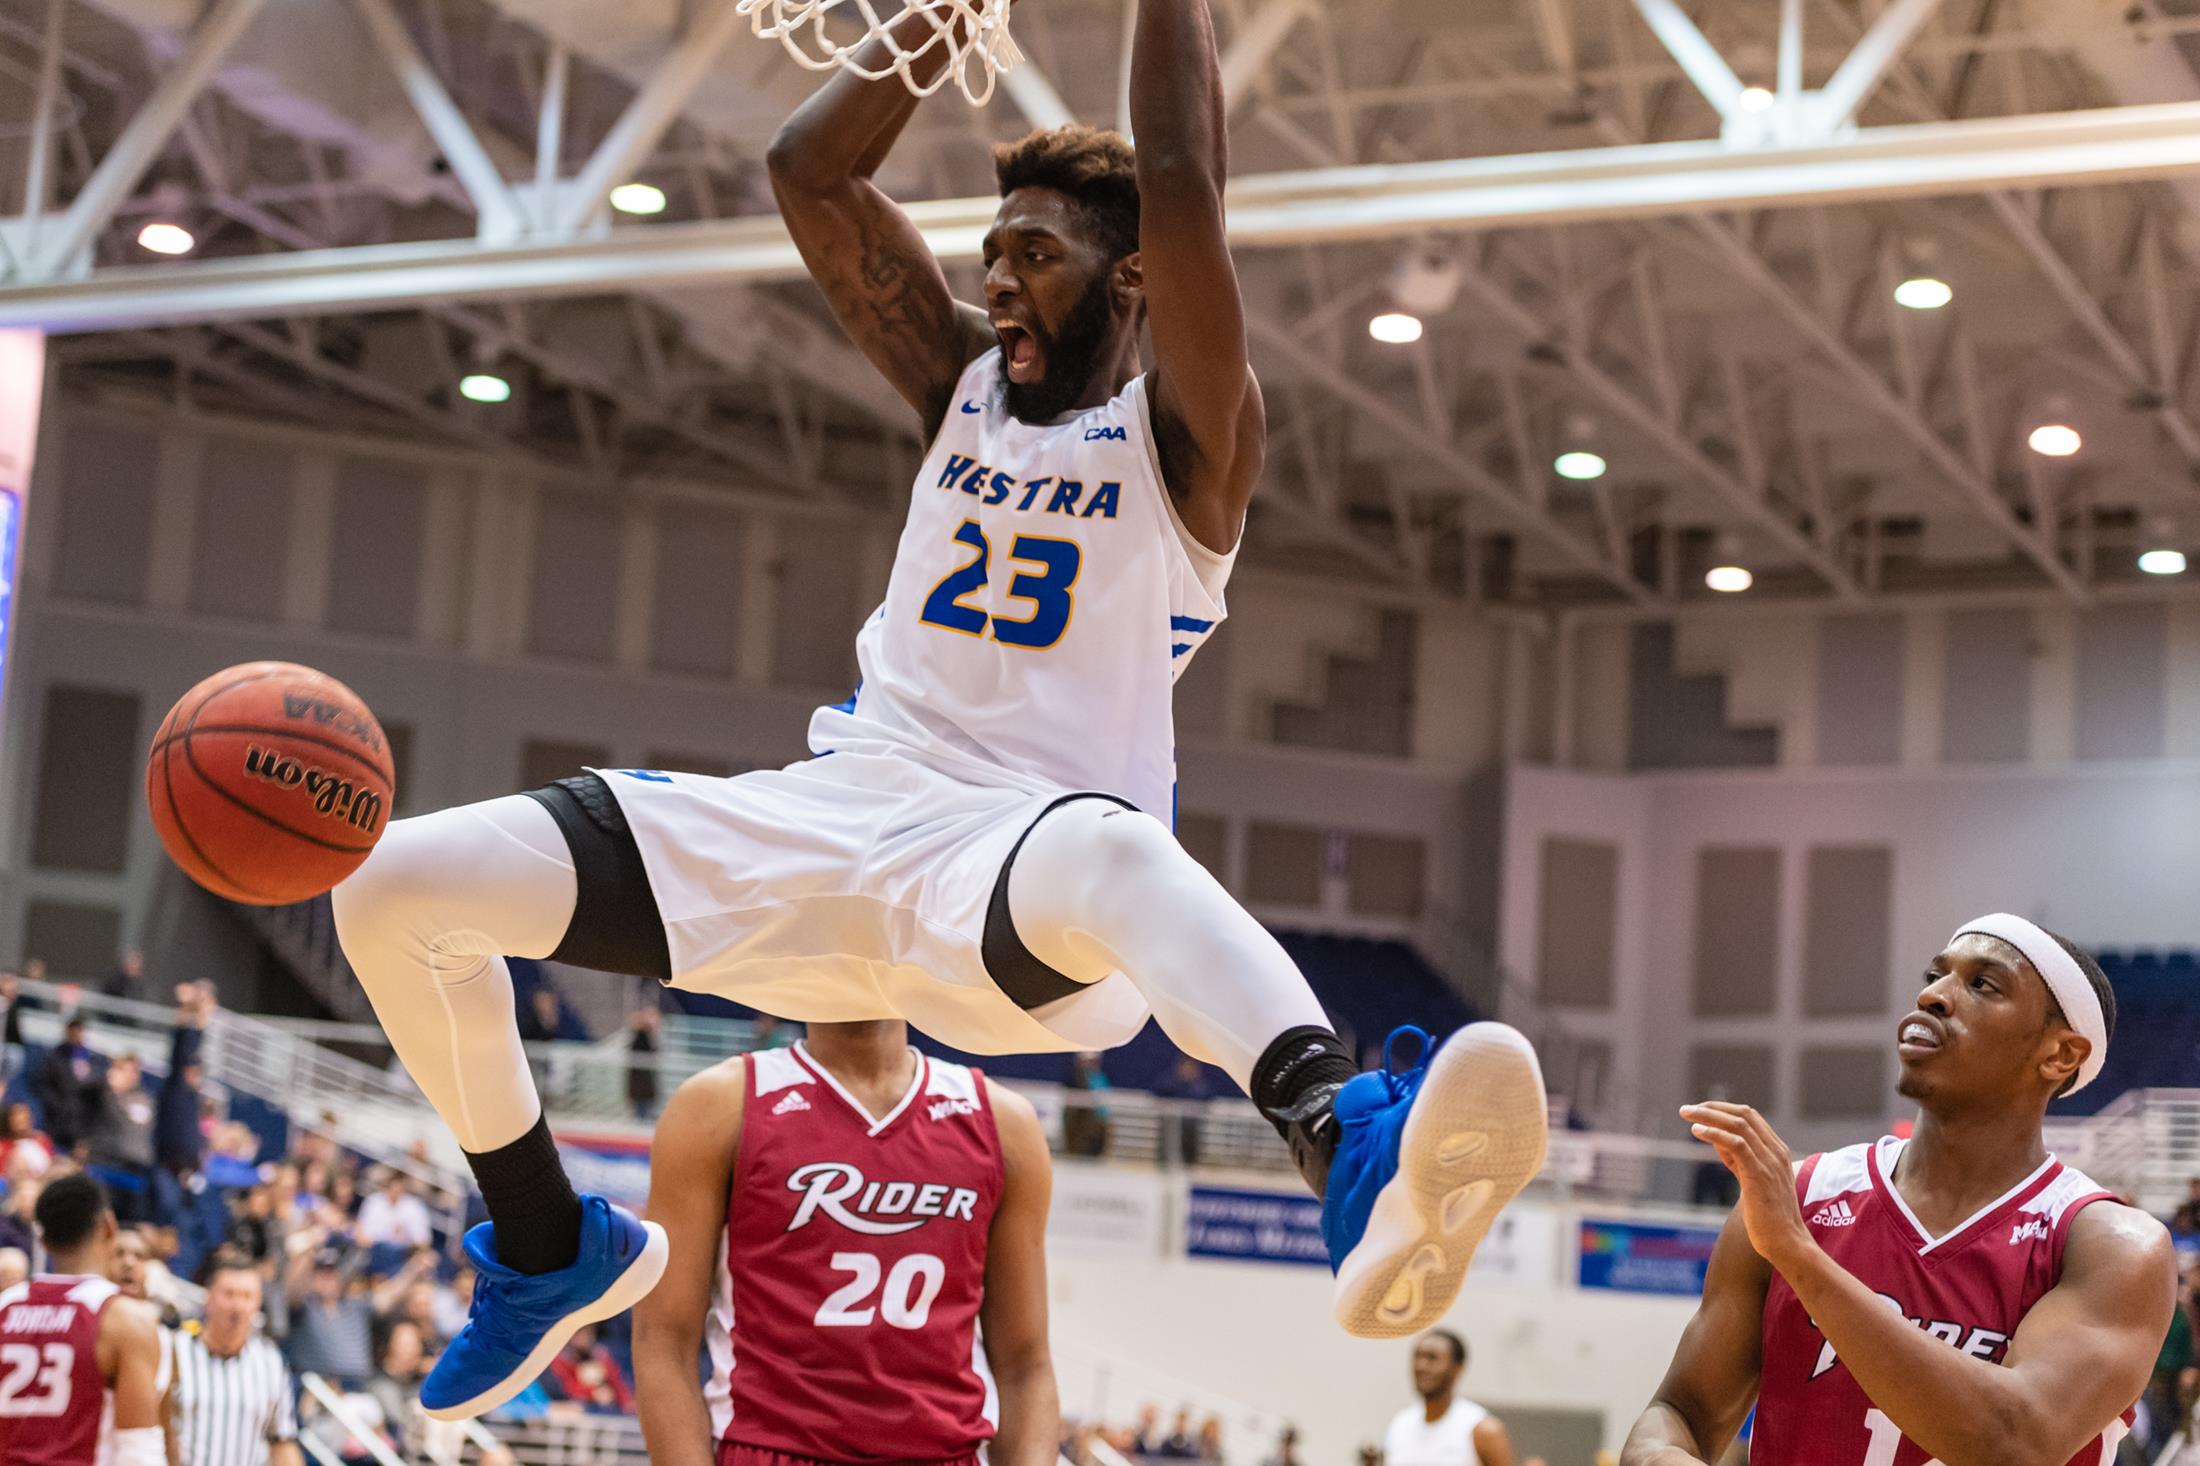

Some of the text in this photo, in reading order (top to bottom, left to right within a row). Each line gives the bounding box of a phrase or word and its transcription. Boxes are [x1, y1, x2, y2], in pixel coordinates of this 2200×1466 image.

[1084, 426, 1127, 441] CAA
[918, 516, 1083, 651] 23
[244, 746, 384, 834] Wilson
[1812, 1215, 1857, 1227] adidas
[813, 1251, 946, 1330] 20
[0, 1343, 75, 1418] 23
